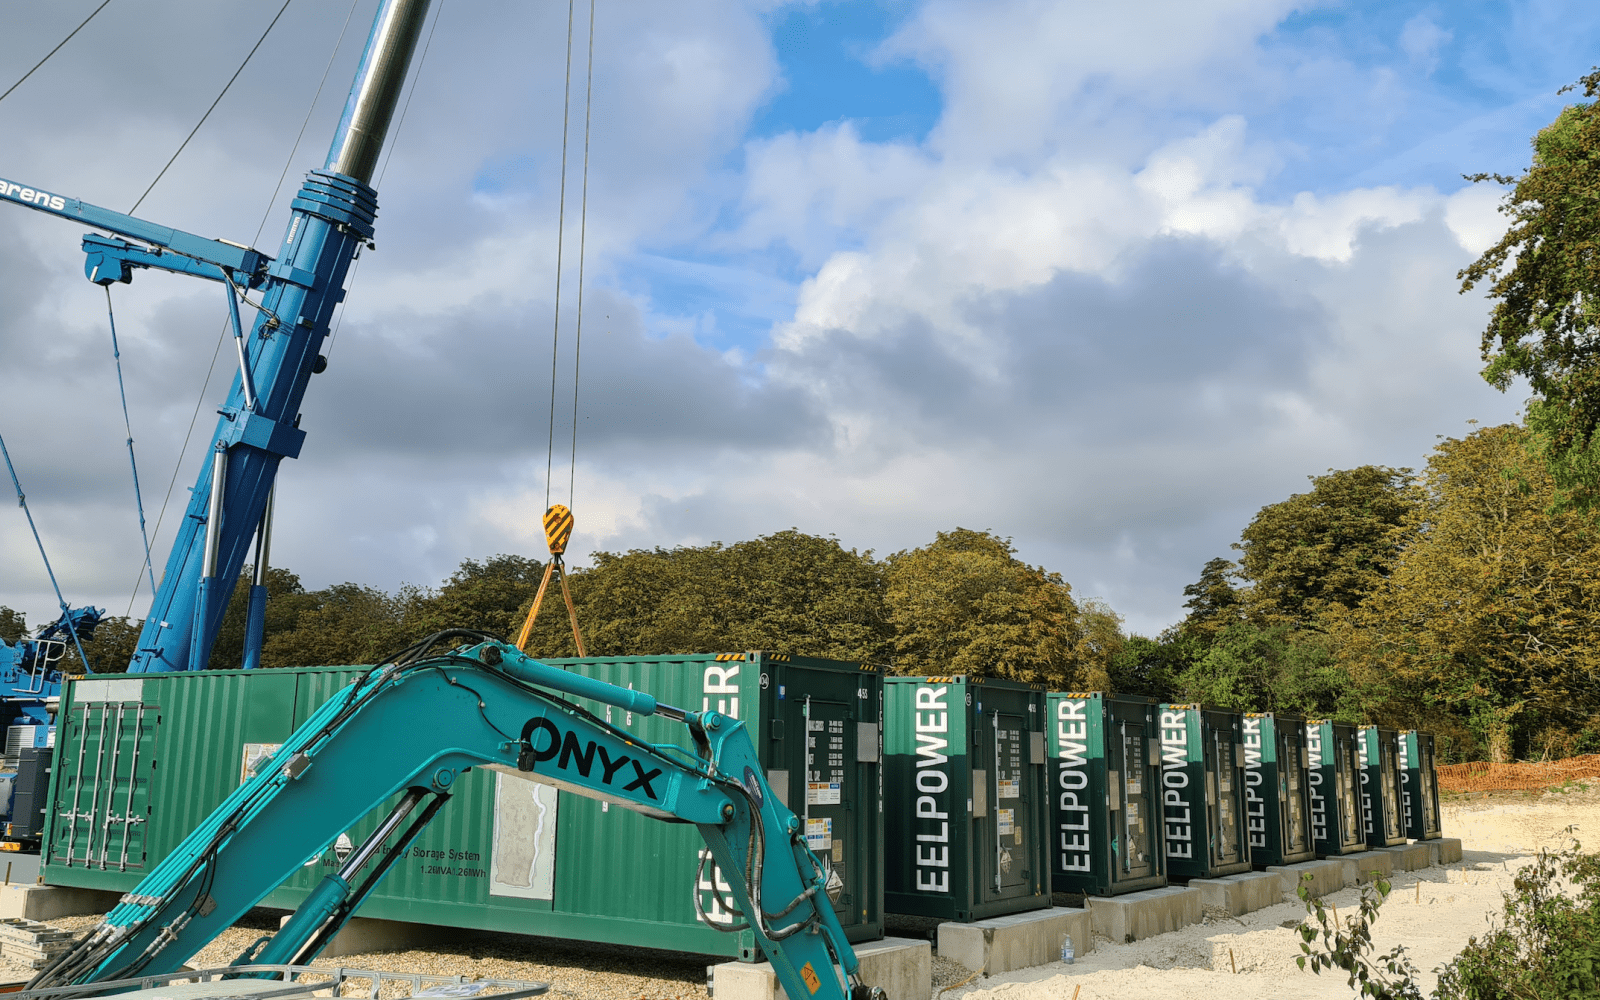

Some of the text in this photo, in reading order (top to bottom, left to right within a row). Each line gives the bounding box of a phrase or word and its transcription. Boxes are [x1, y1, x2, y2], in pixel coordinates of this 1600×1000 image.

[520, 716, 663, 801] ONYX
[916, 686, 949, 893] EELPOWER
[1058, 700, 1090, 872] EELPOWER
[1160, 711, 1193, 859] EELPOWER
[448, 849, 480, 861] System
